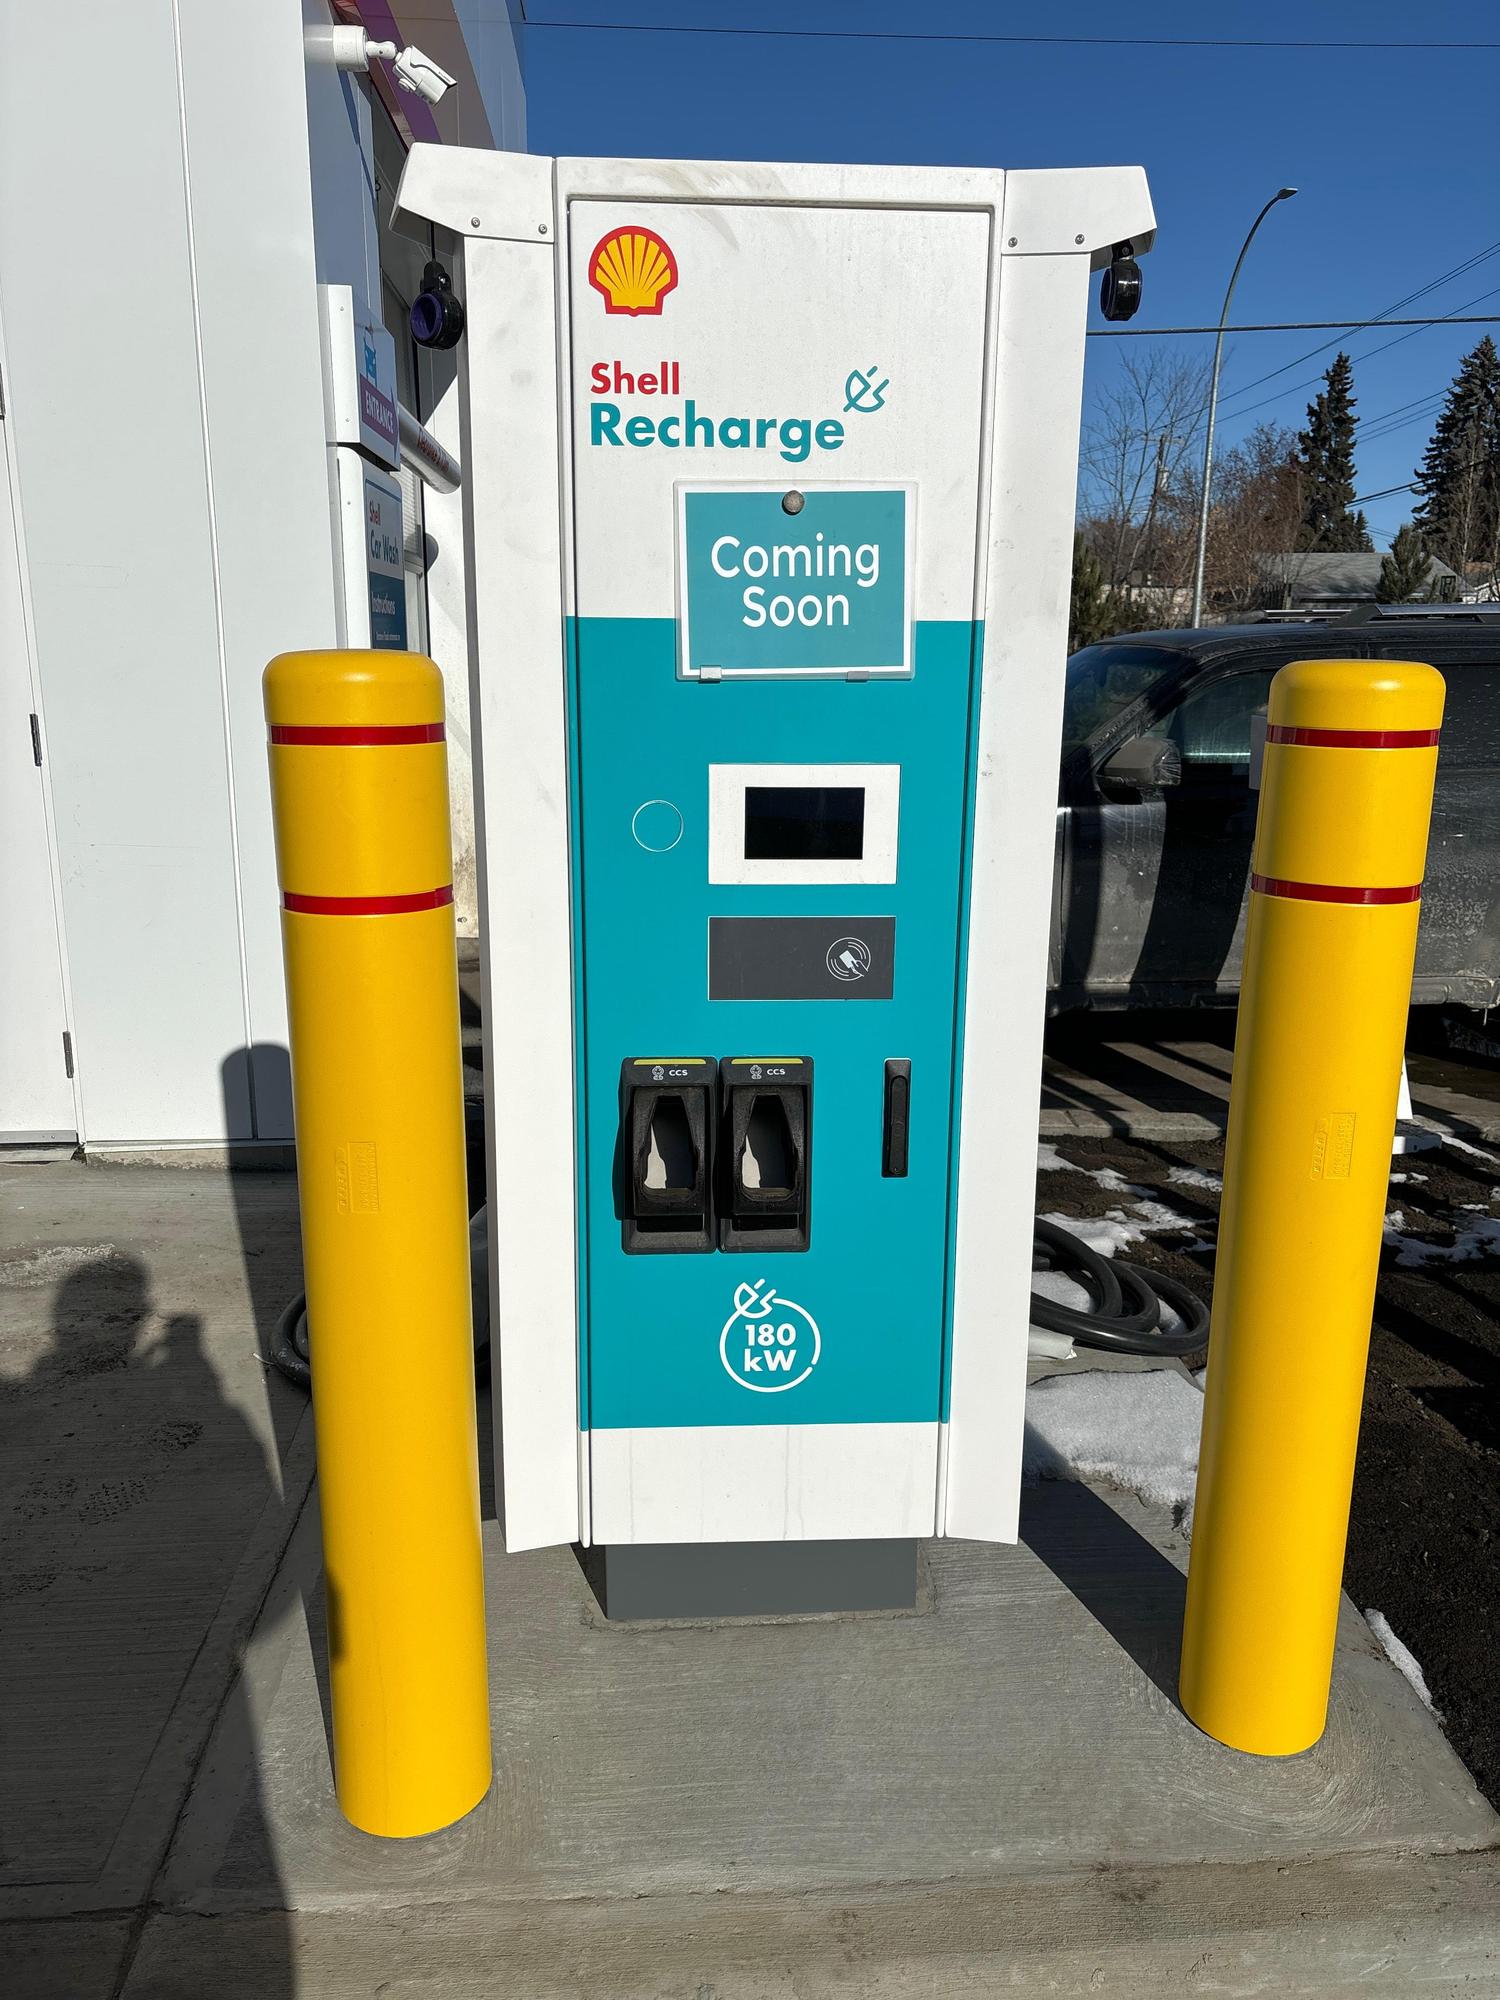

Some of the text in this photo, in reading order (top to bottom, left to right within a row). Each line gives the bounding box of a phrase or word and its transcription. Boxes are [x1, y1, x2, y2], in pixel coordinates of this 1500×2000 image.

[590, 360, 680, 395] Shell
[365, 389, 395, 434] ENTRANCE
[590, 400, 845, 463] Recharge
[370, 529, 400, 566] Car Wash
[710, 532, 881, 588] Coming
[742, 586, 850, 627] Soon
[668, 1068, 689, 1077] CCS
[766, 1067, 786, 1076] CCS
[745, 1322, 797, 1347] 180
[743, 1348, 797, 1372] kW
